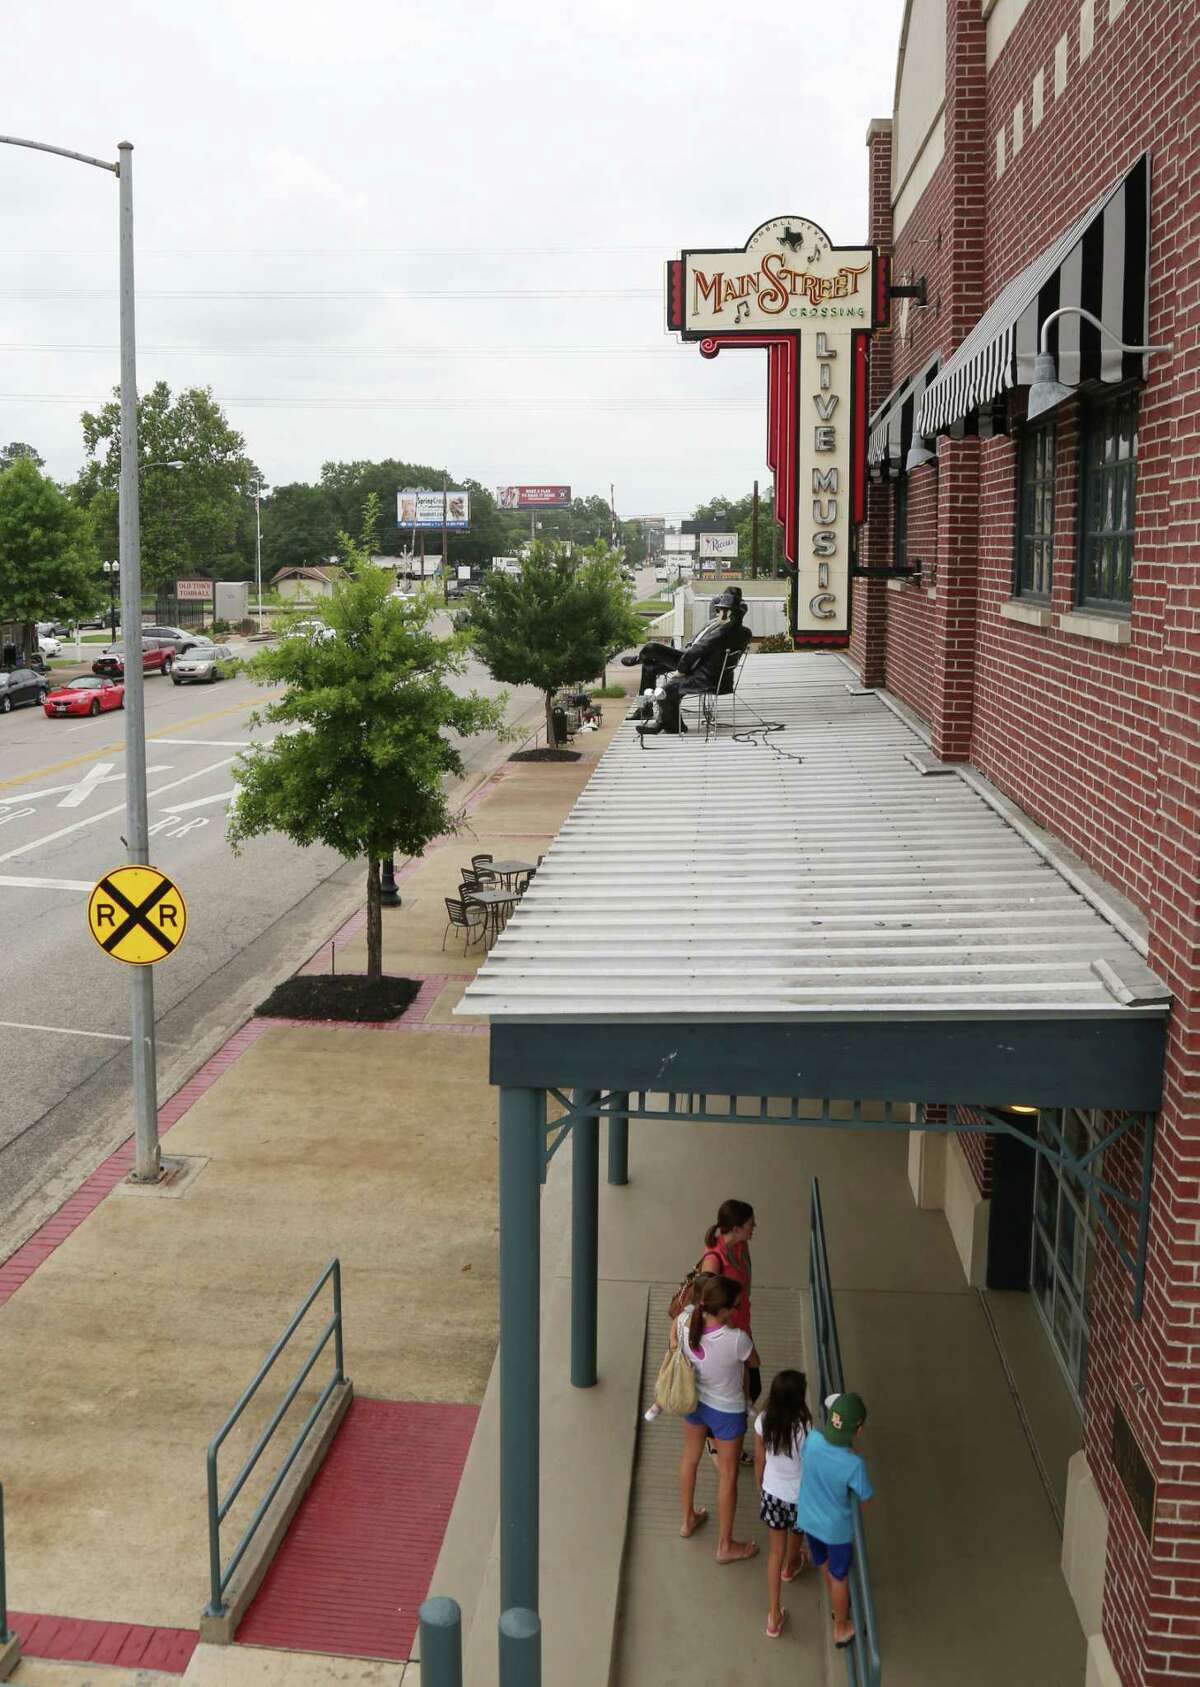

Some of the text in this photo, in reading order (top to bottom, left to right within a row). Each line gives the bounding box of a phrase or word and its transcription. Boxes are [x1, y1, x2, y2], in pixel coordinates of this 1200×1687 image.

[748, 219, 829, 249] TOMBALL TEXAS
[789, 306, 865, 319] CROSSING
[809, 331, 840, 620] LIVE MUSIC
